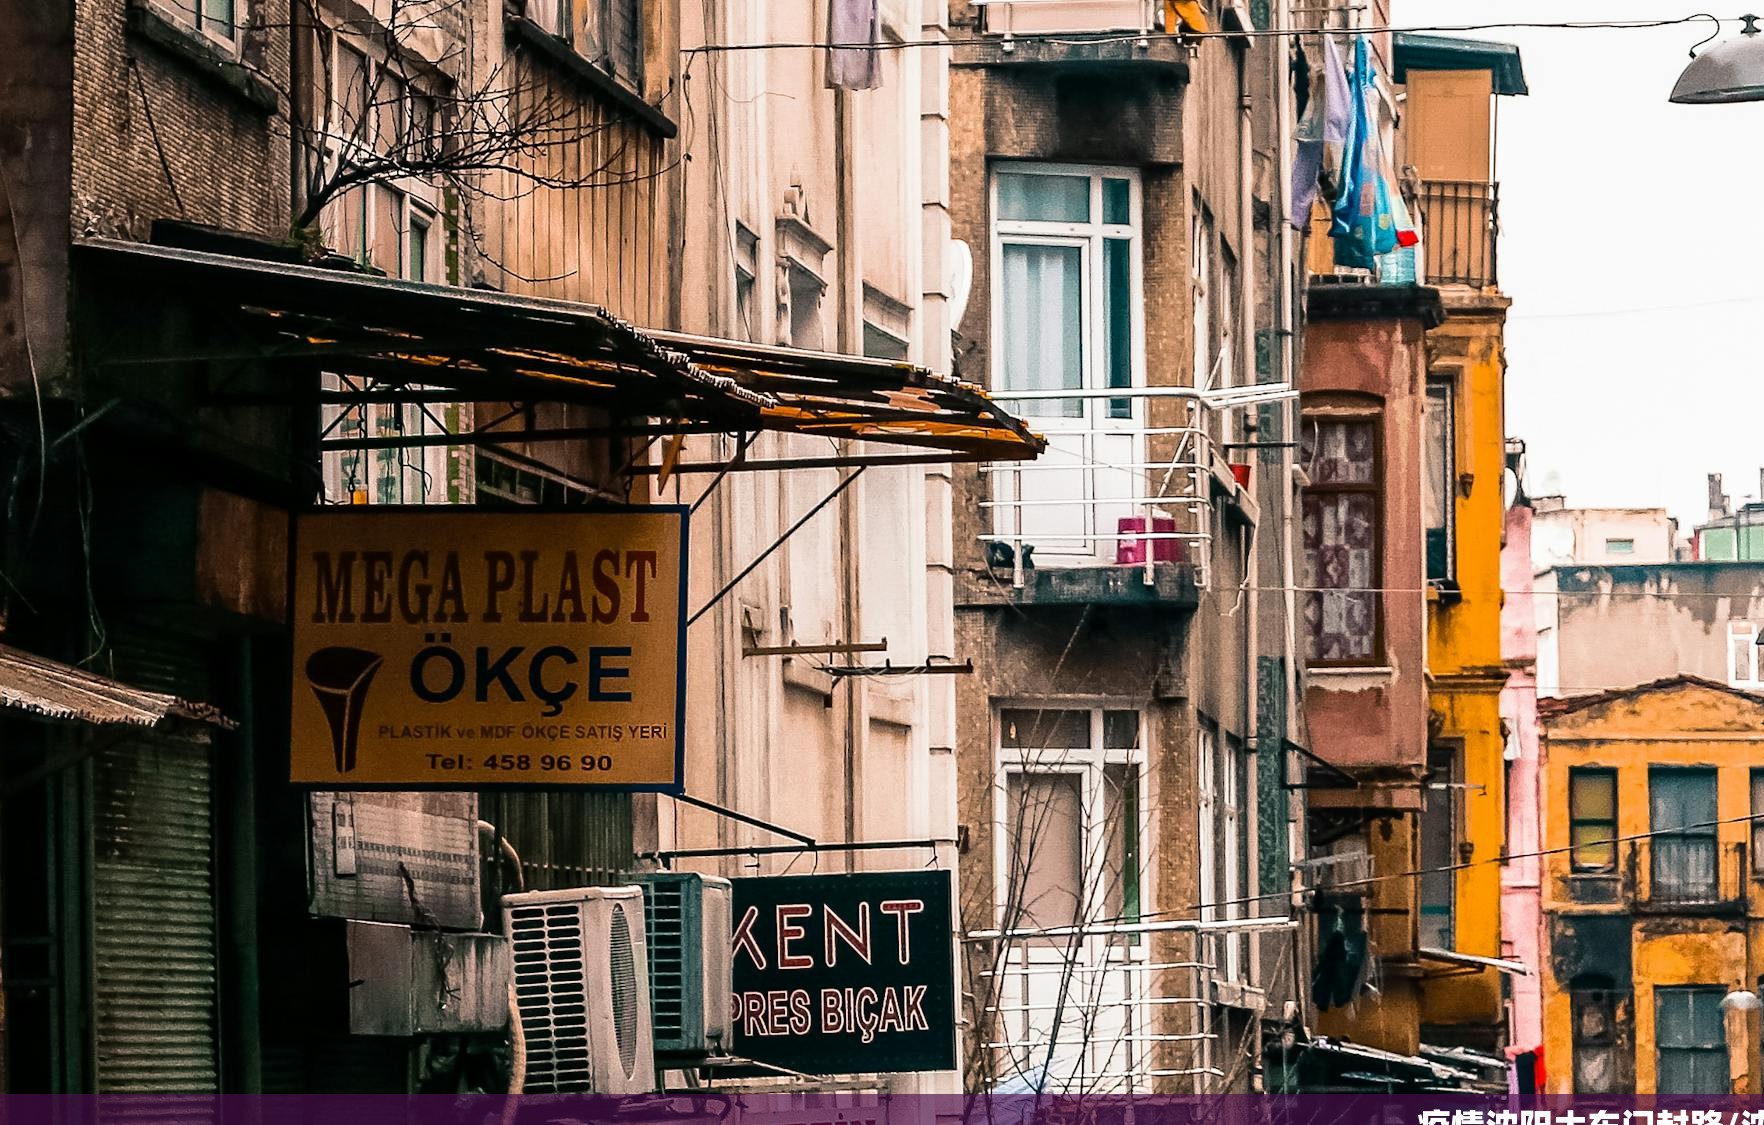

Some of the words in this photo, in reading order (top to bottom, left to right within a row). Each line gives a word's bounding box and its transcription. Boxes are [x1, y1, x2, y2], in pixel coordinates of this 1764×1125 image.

[311, 549, 469, 624] MEGA
[481, 548, 657, 625] PLAST
[409, 632, 633, 718] ÖKÇE
[378, 723, 452, 739] PLASTİK
[456, 727, 476, 739] ve
[480, 724, 516, 739] MDF
[521, 721, 571, 742] ÖKÇE
[575, 724, 625, 742] SATIŞ
[629, 721, 668, 740] YERİ
[425, 753, 473, 770] Tel:
[483, 754, 531, 771] 458
[541, 755, 572, 770] 96
[580, 755, 613, 770] 90
[732, 899, 924, 970] KENT
[820, 985, 929, 1043] BIÇAK
